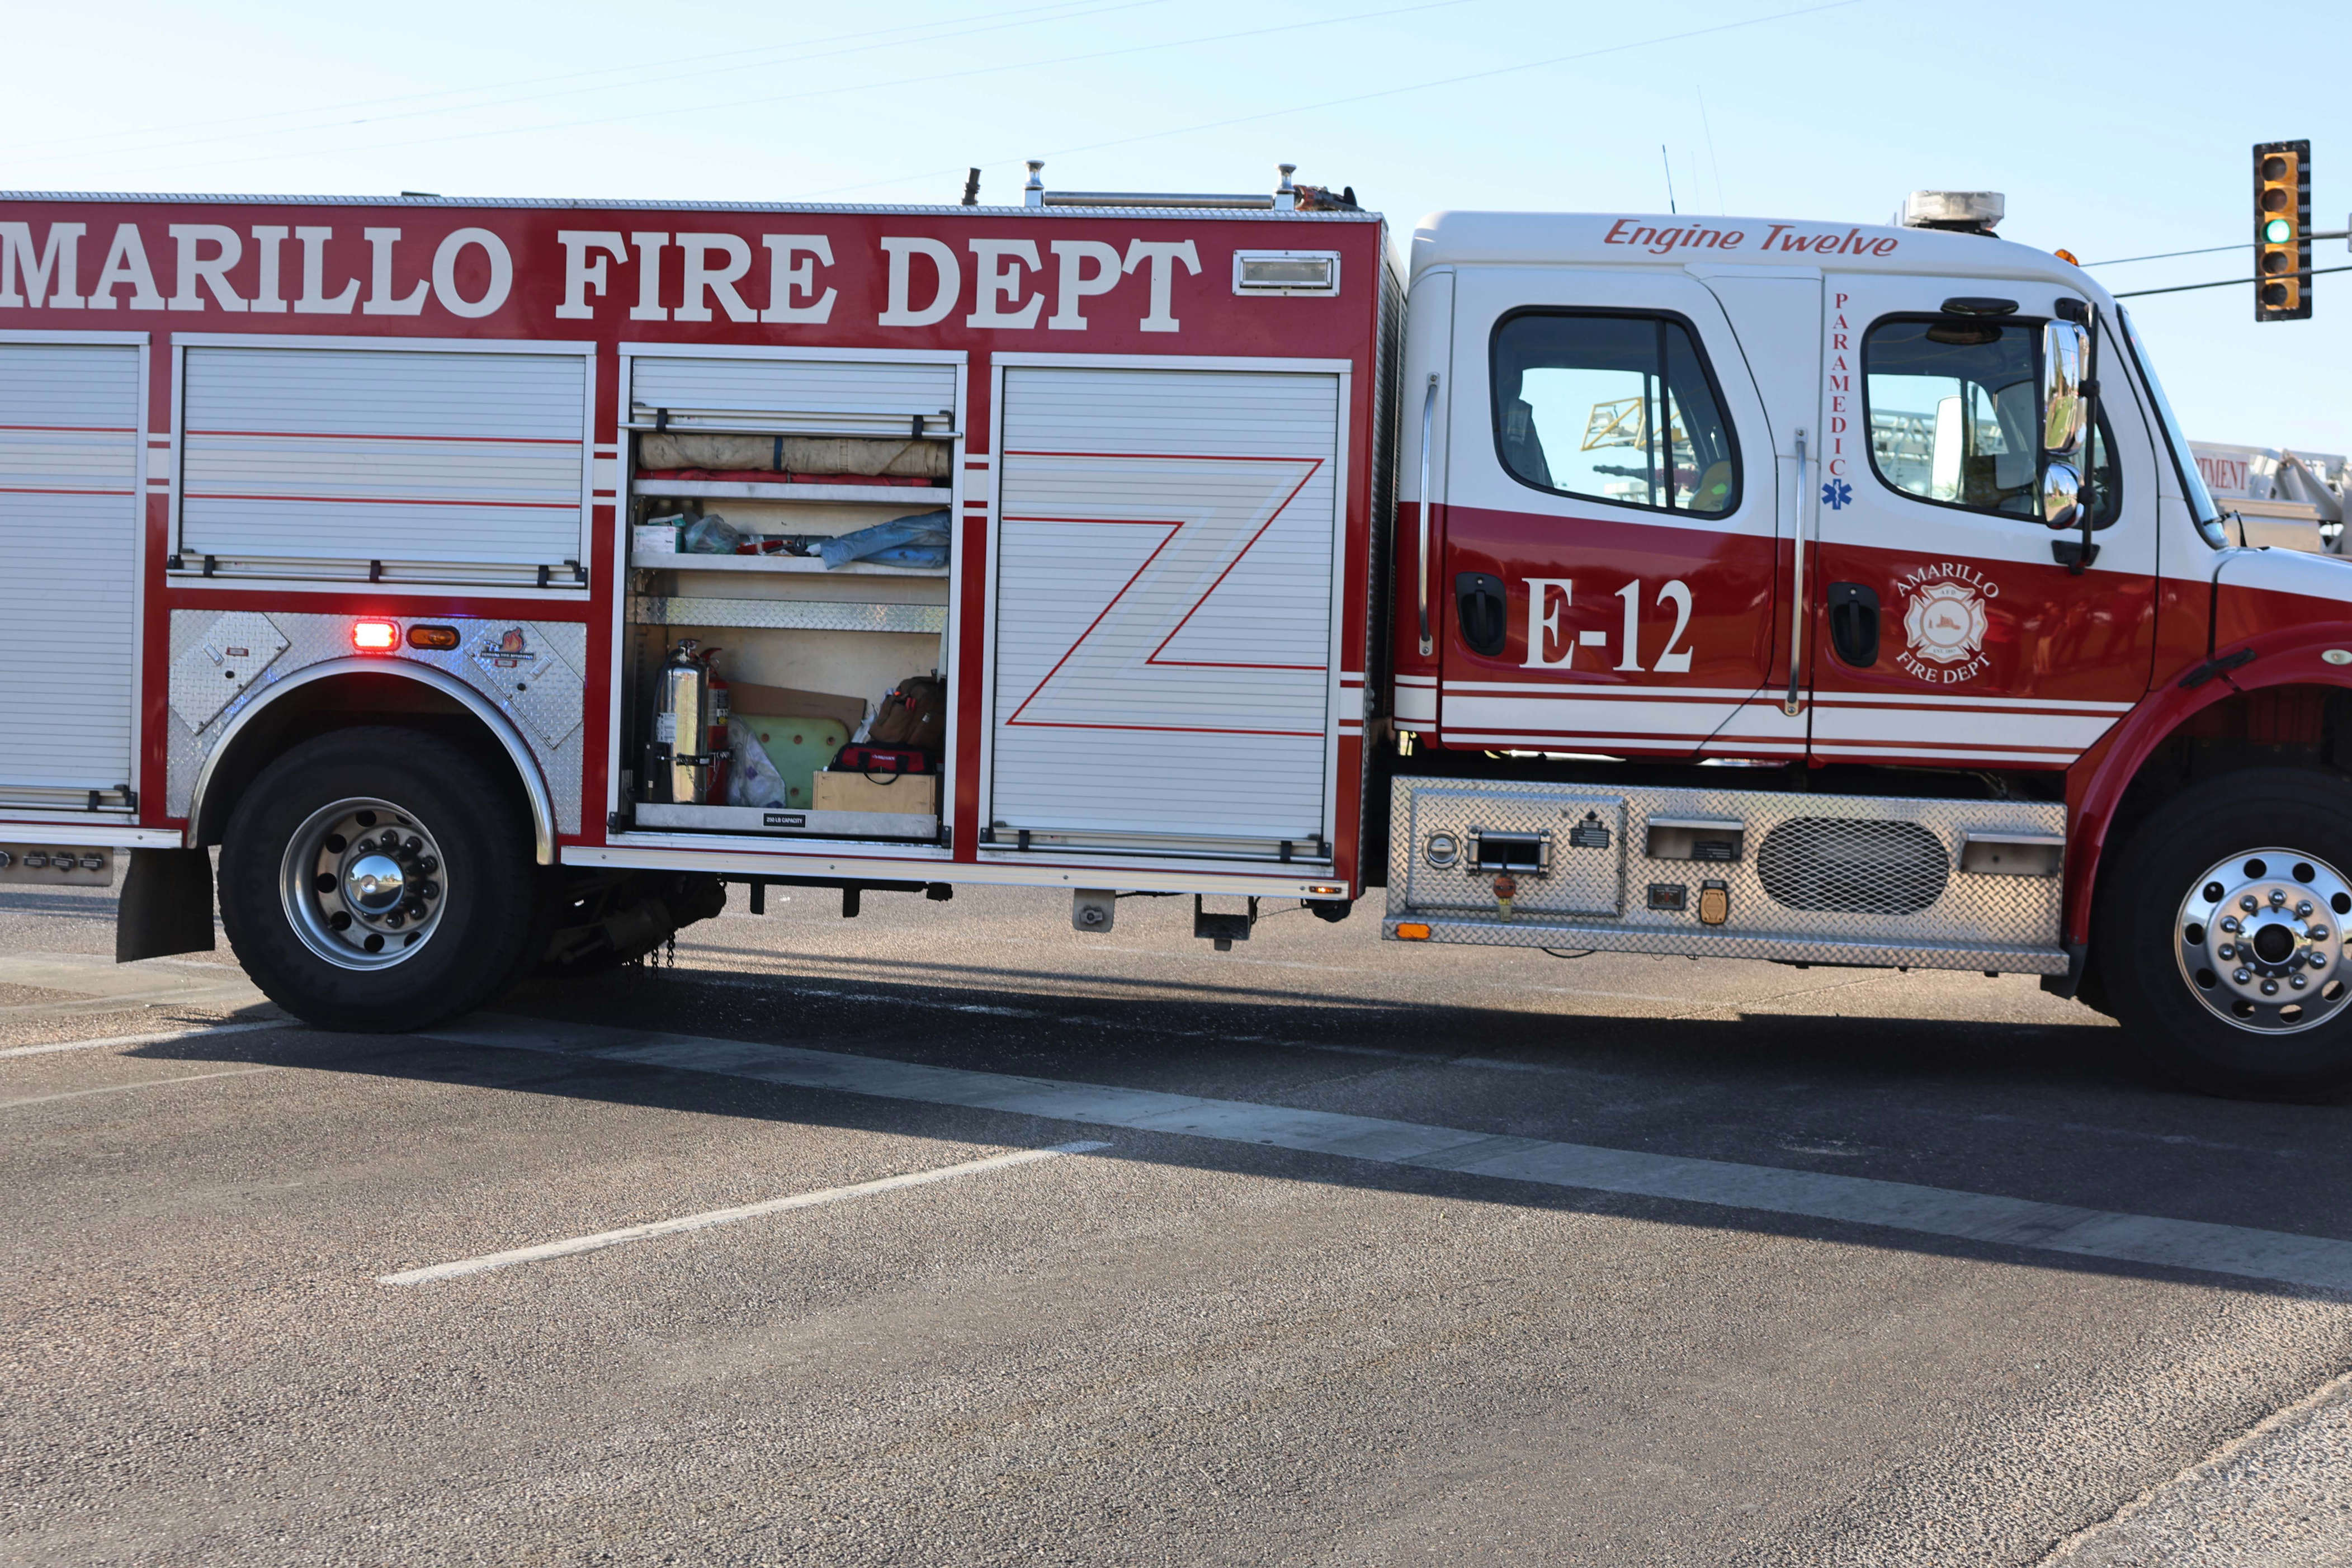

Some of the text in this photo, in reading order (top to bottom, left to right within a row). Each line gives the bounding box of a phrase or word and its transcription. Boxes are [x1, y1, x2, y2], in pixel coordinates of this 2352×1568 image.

[1604, 219, 1898, 257] Engine Twelve
[0, 221, 1202, 332] MARILLO FIRE DEPT
[1829, 294, 1849, 475] PARAMEDIC
[2194, 457, 2247, 490] TMENT
[1897, 563, 1999, 598] AMARILLO
[1519, 578, 1694, 673] E-12
[1896, 650, 1991, 684] FIRE DEPT
